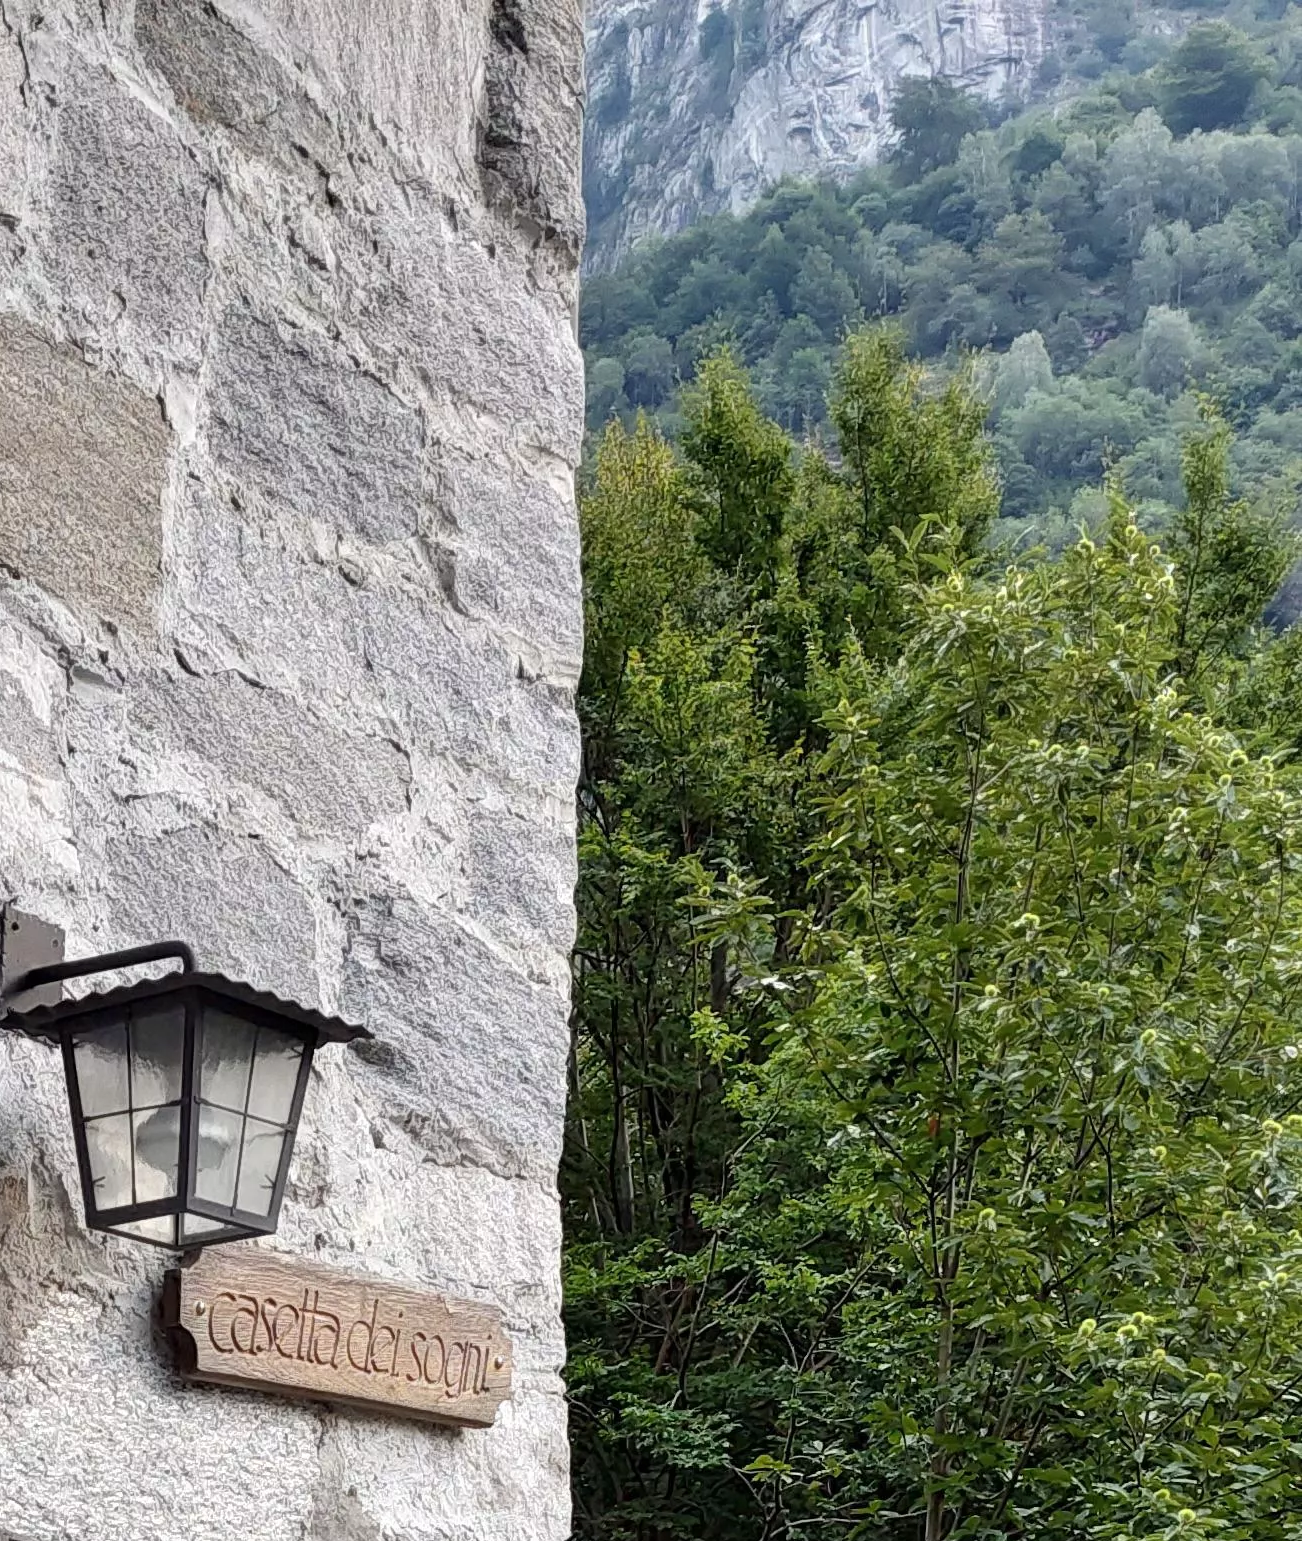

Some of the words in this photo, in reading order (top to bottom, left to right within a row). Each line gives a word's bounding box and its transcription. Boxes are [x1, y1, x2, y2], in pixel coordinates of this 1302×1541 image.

[208, 1288, 340, 1369] casetta
[347, 1298, 403, 1377] dei
[406, 1334, 494, 1398] sogni
